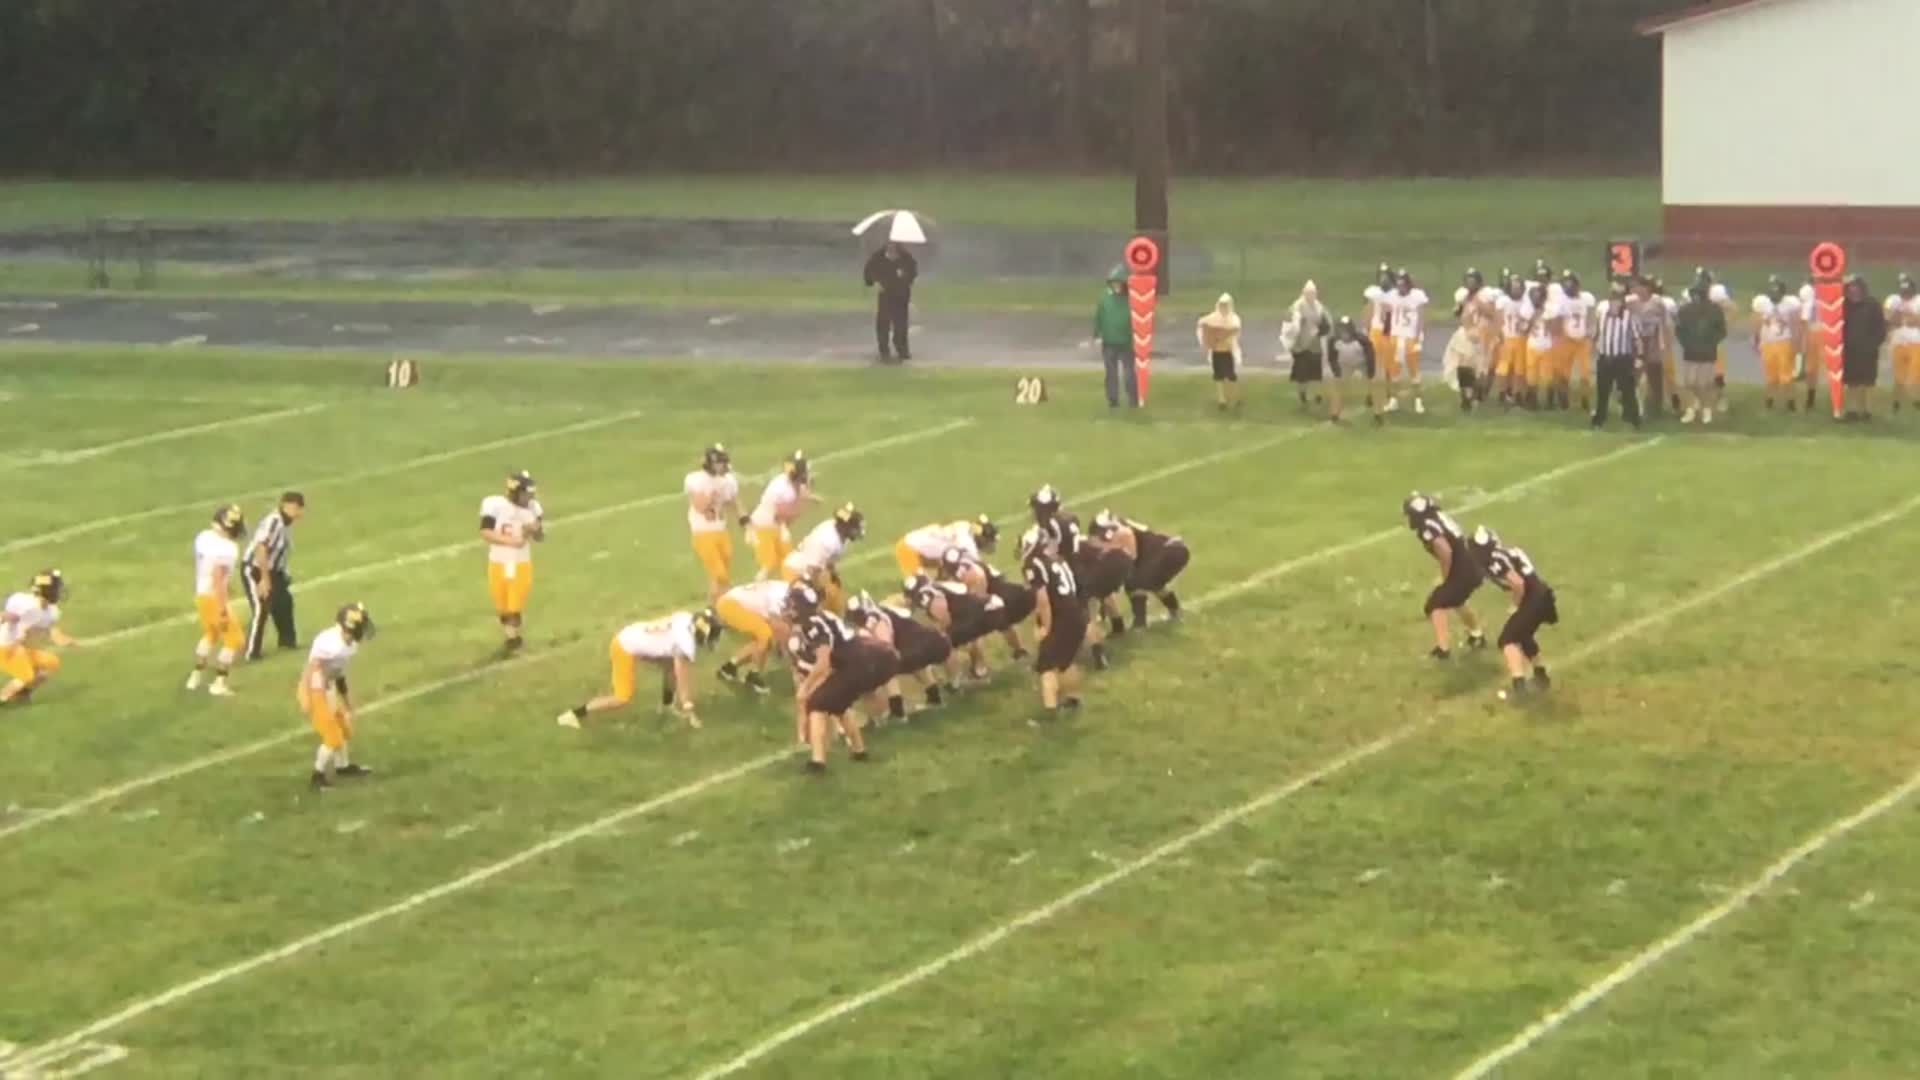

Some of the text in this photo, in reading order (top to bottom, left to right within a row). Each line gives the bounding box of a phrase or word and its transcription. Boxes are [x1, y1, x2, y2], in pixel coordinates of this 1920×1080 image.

[1611, 245, 1633, 273] 3
[389, 360, 411, 388] 10
[1015, 377, 1041, 404] 20
[1051, 561, 1077, 596] 31
